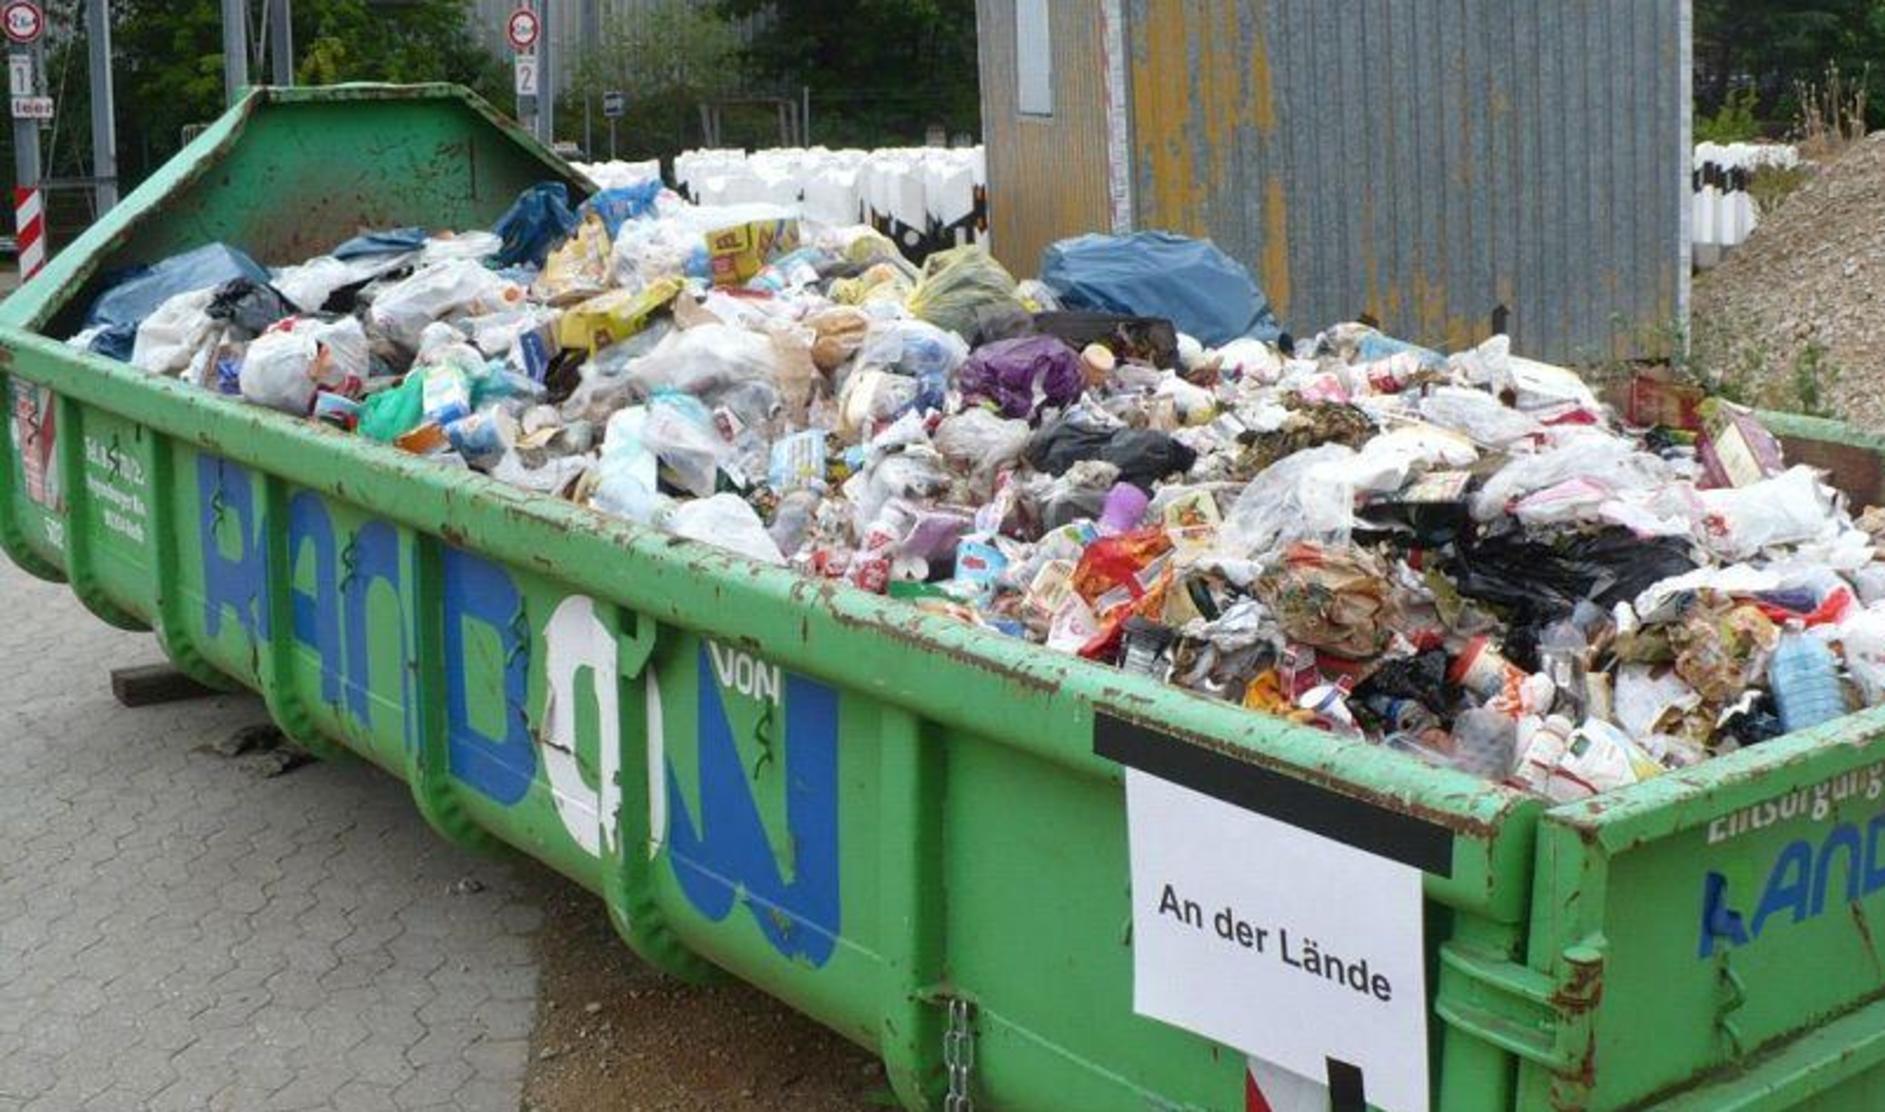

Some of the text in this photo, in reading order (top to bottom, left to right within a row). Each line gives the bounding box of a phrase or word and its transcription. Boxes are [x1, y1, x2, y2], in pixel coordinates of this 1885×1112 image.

[15, 66, 25, 93] 1
[520, 65, 533, 92] 2
[709, 639, 781, 707] VON
[1158, 883, 1392, 1002] An der Lände
